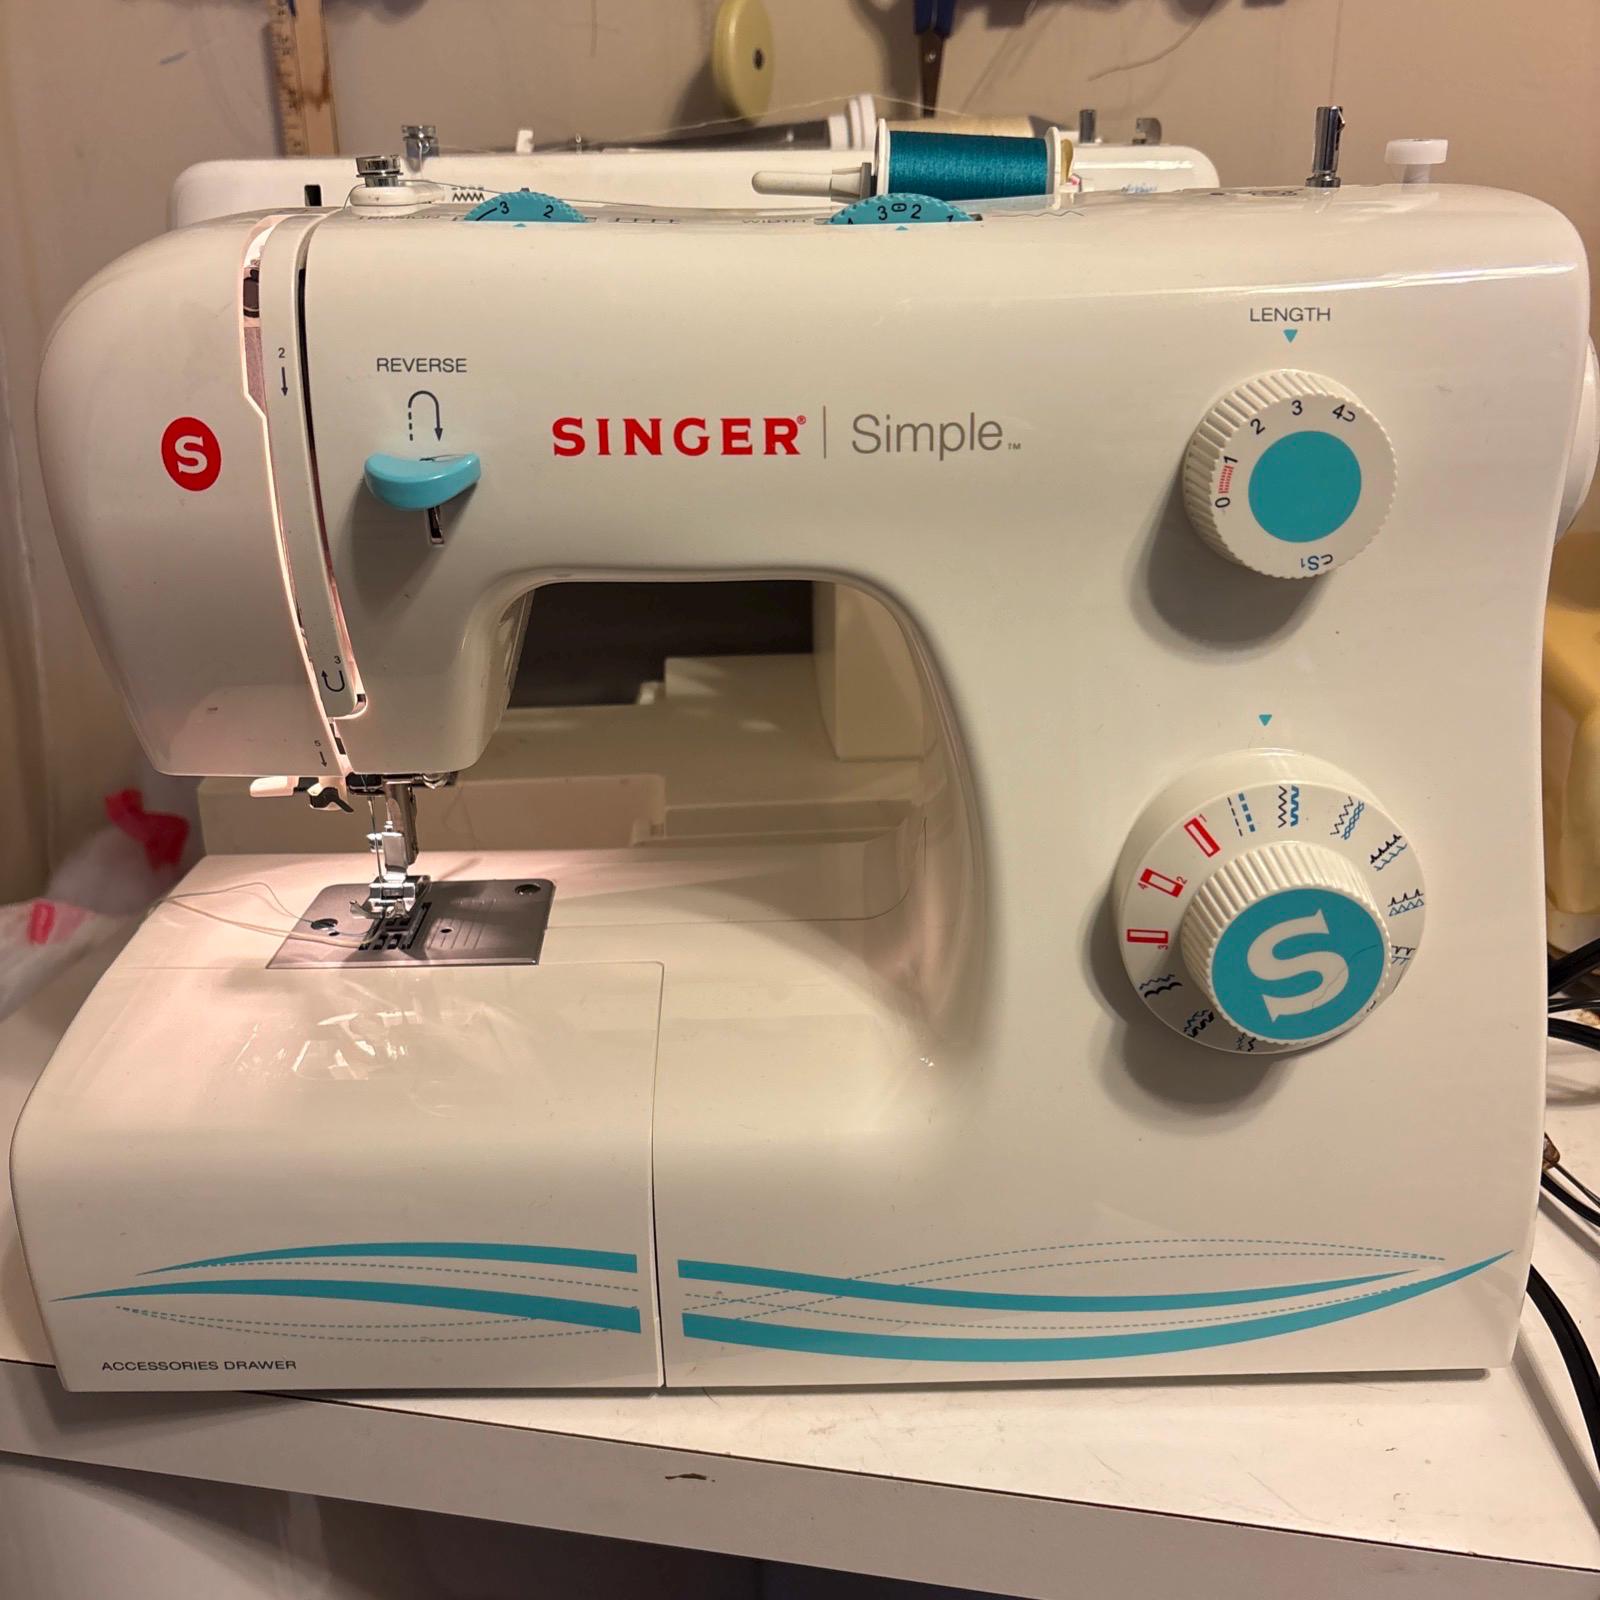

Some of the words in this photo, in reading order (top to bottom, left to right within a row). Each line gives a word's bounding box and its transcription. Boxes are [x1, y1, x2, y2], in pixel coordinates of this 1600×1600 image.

[500, 201, 510, 215] 3
[543, 204, 554, 219] 2
[877, 205, 888, 221] 3
[910, 204, 922, 219] 2
[1249, 307, 1331, 322] LENGTH
[278, 347, 285, 359] 2
[376, 358, 467, 373] REVERSE
[174, 435, 208, 474] S
[1214, 497, 1231, 509] 0
[1223, 455, 1238, 464] 1
[1250, 418, 1266, 435] 2
[1291, 400, 1303, 416] 3
[334, 656, 341, 664] 3
[1176, 876, 1187, 885] 2
[1247, 908, 1349, 1023] S
[101, 1361, 219, 1372] ACCESSORIES
[224, 1360, 297, 1371] DRAWER
